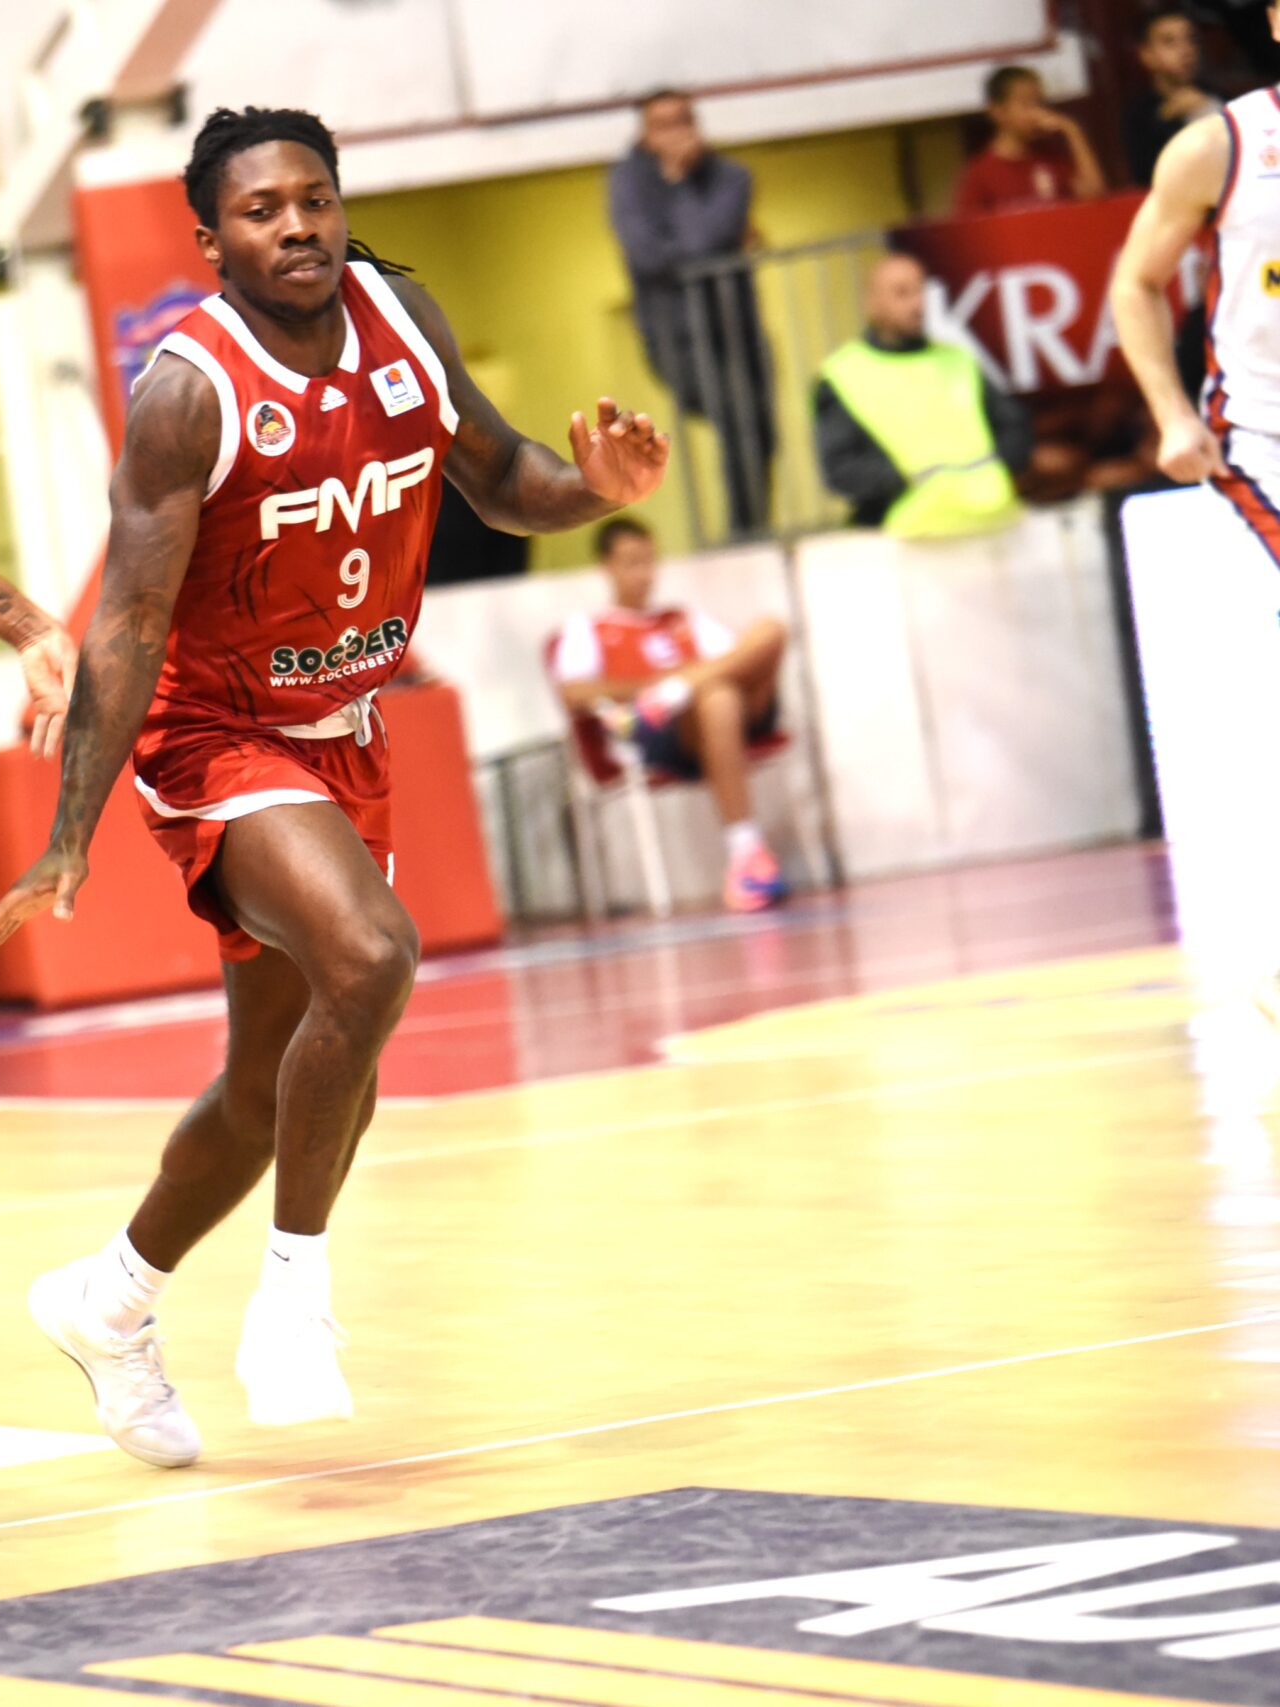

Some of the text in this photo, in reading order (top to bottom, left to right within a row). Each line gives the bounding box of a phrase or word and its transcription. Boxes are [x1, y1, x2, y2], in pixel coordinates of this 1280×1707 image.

[259, 446, 435, 540] FMP
[337, 548, 371, 609] 9
[270, 616, 408, 676] SOCCER
